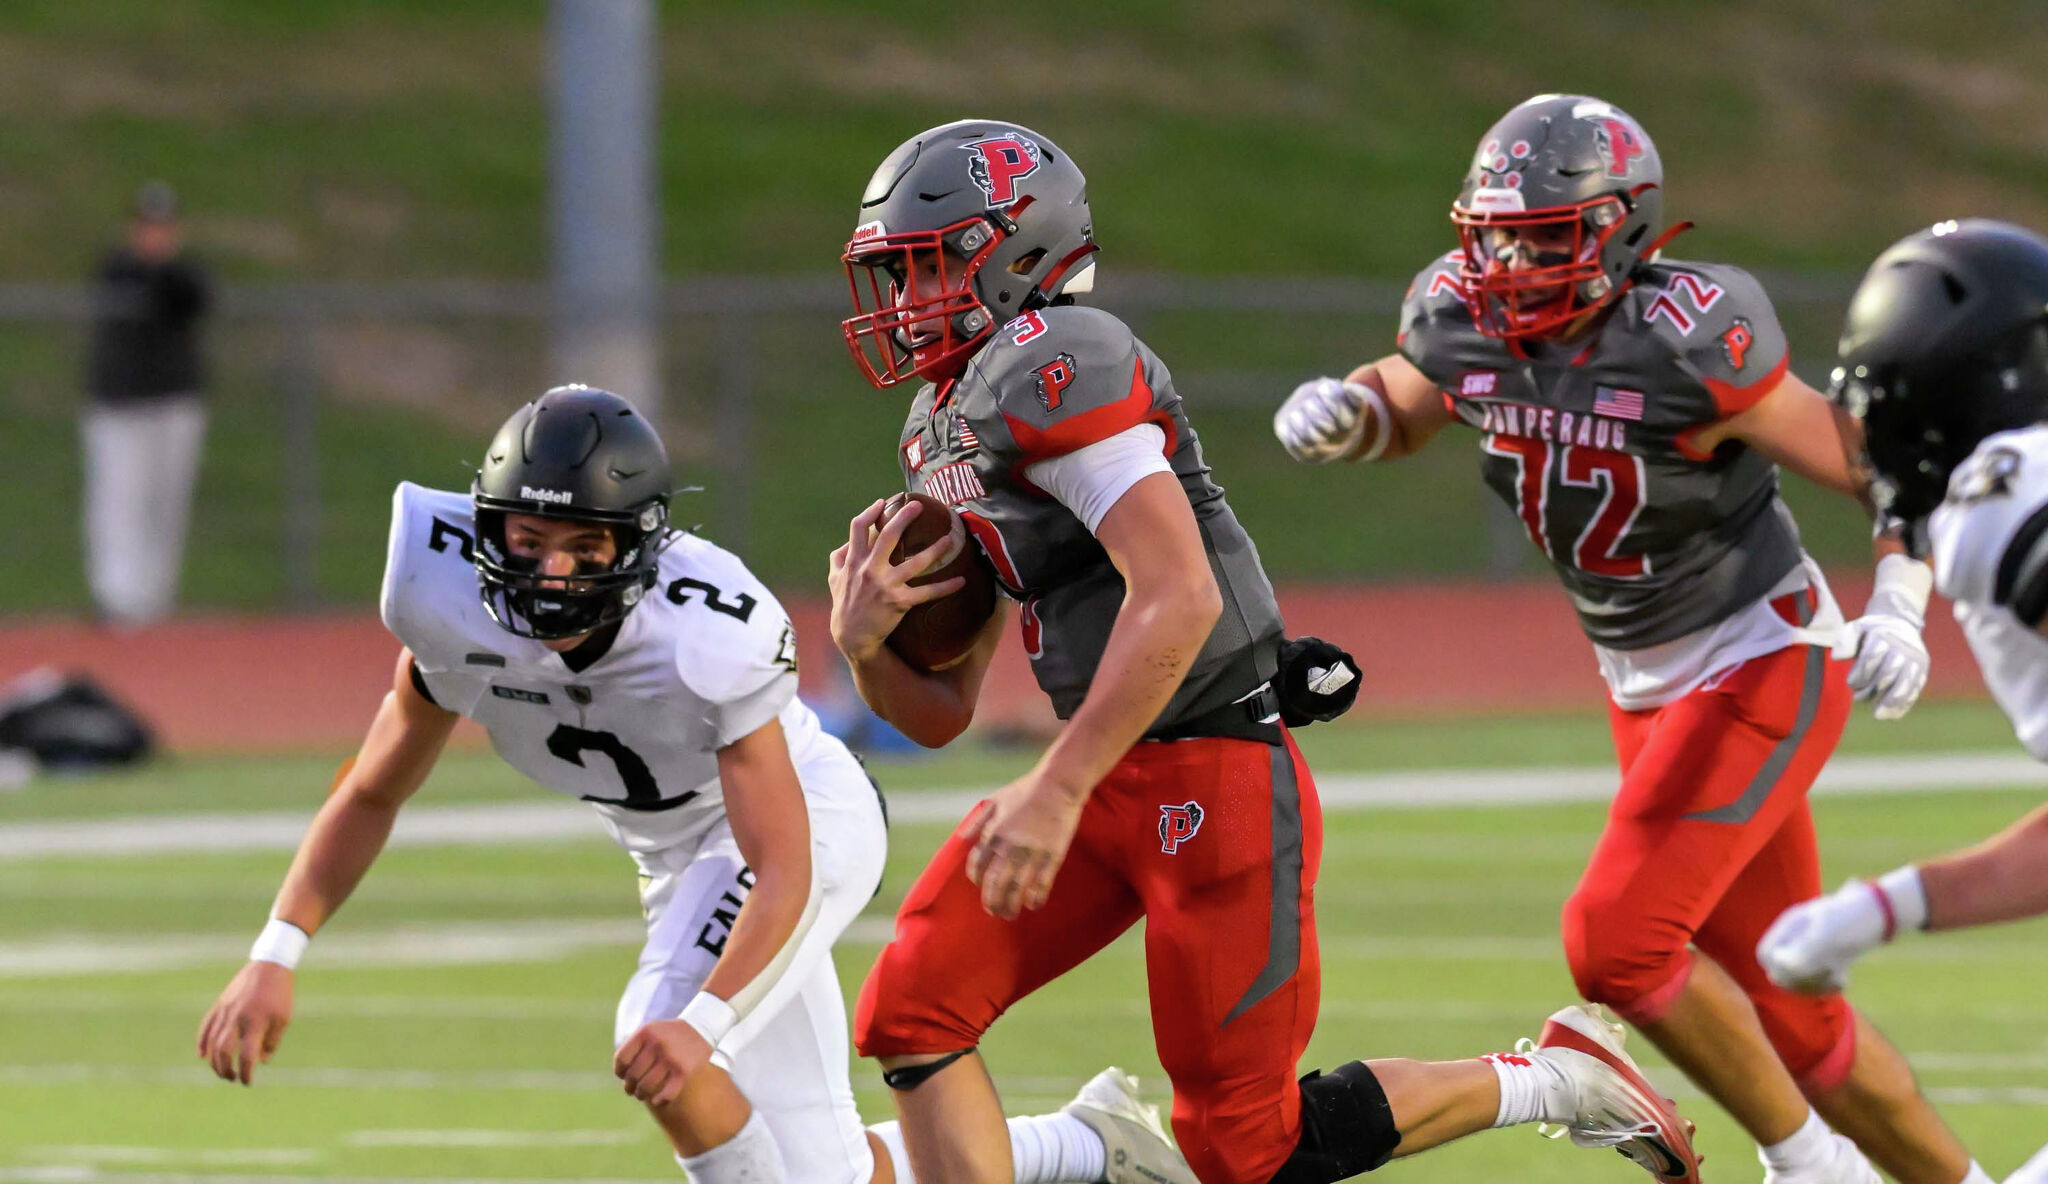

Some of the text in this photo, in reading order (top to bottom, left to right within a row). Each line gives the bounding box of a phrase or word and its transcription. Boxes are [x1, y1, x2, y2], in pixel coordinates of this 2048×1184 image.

[966, 133, 1041, 208] P
[1600, 117, 1646, 180] P
[1004, 310, 1049, 347] 3
[1644, 272, 1724, 337] 72
[1720, 318, 1753, 370] P
[1029, 353, 1077, 413] P
[1462, 373, 1497, 395] SWC
[520, 486, 573, 505] Riddell
[1481, 434, 1653, 581] 72
[667, 577, 758, 625] 2
[547, 723, 700, 812] 2
[1158, 800, 1205, 856] P
